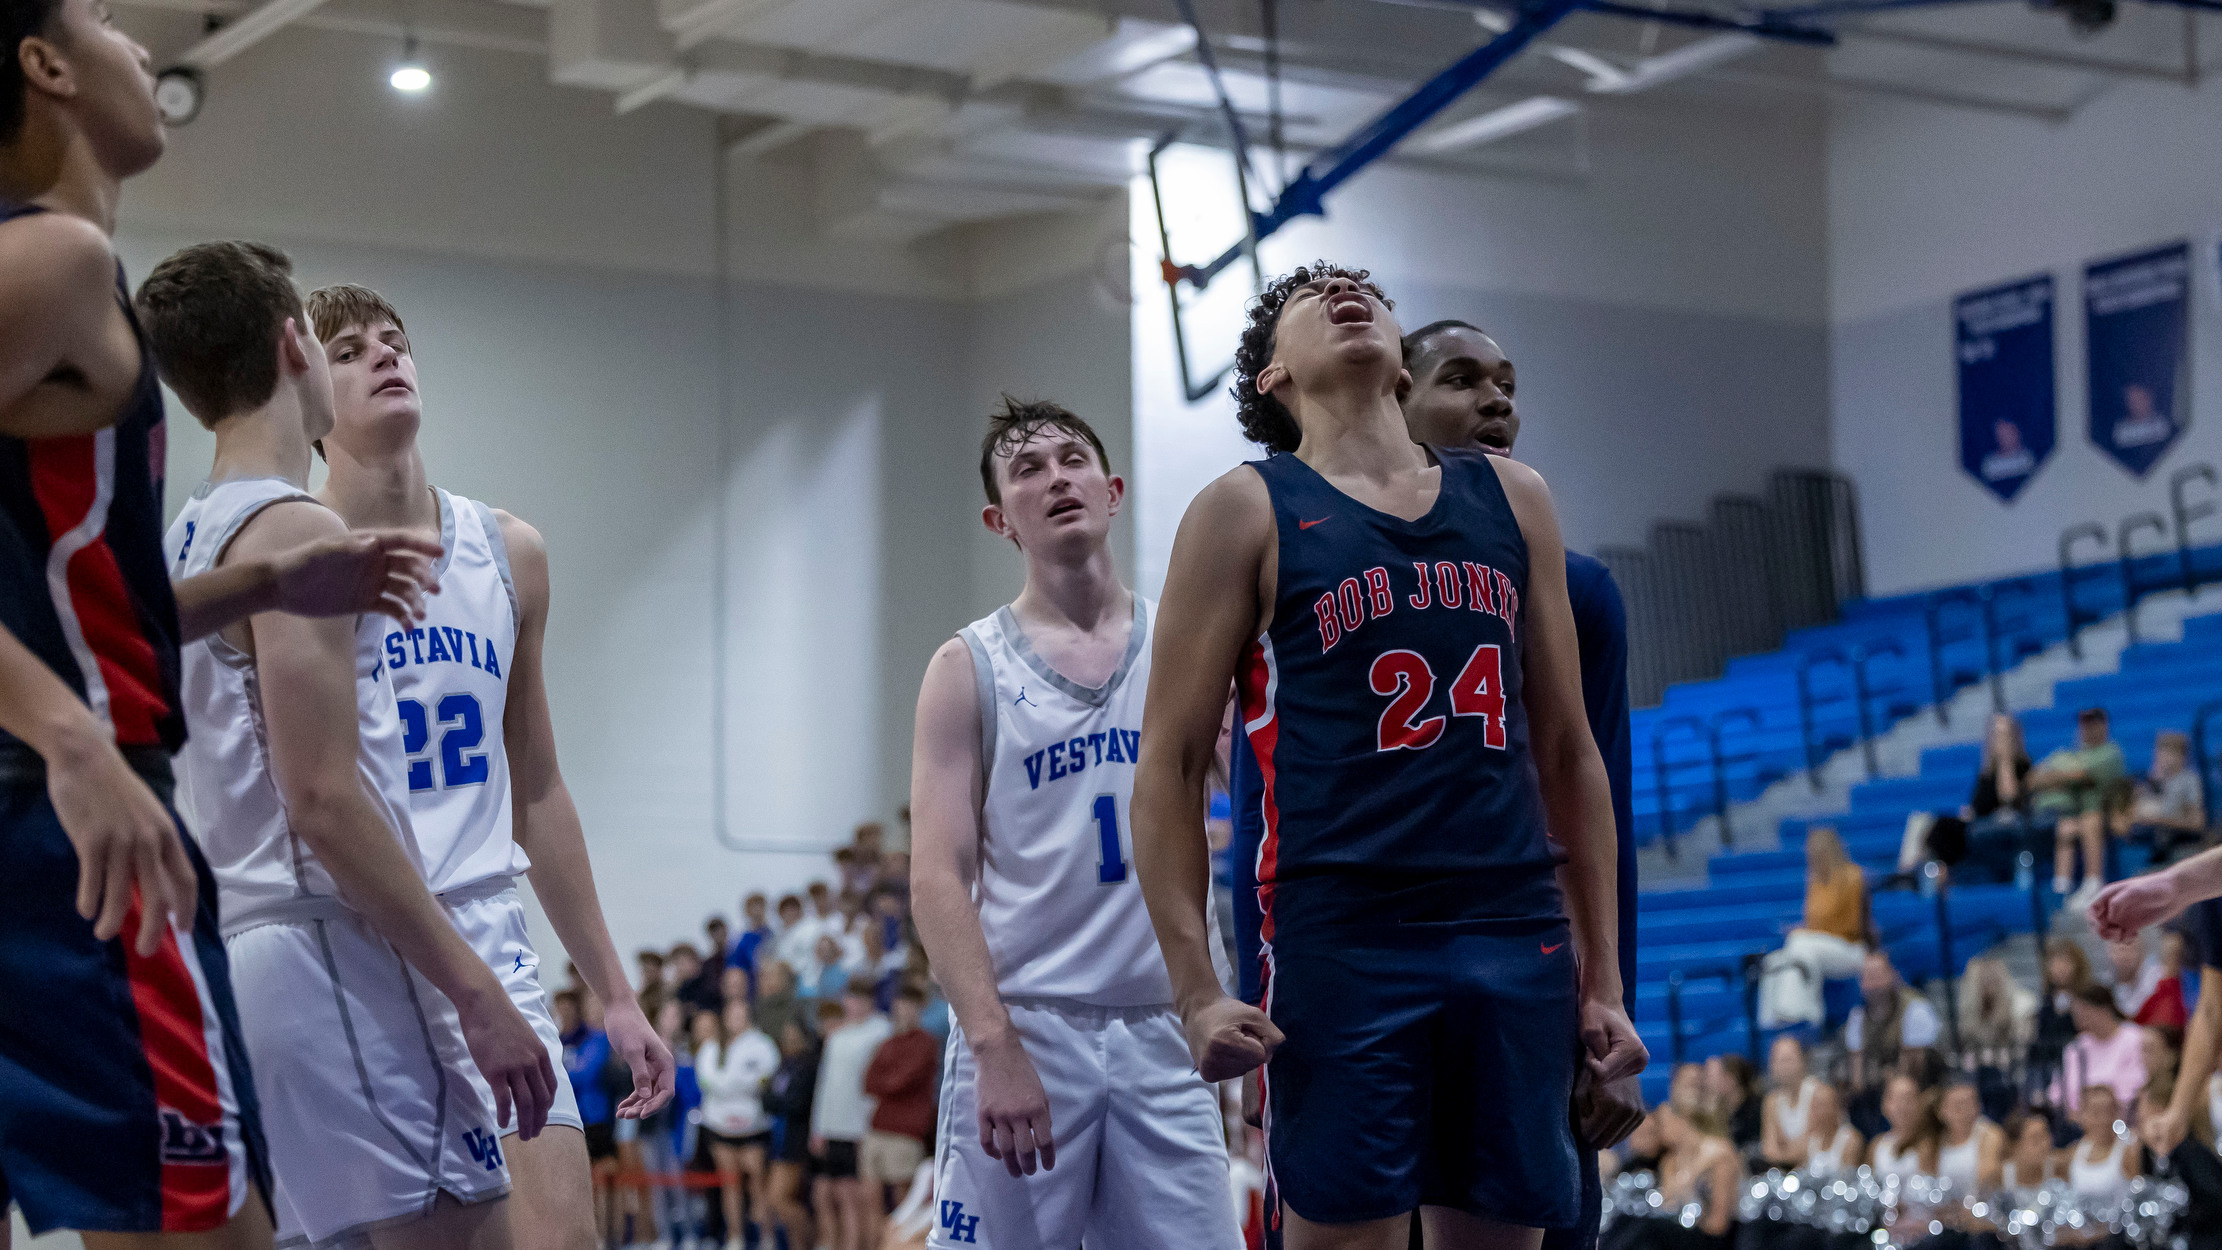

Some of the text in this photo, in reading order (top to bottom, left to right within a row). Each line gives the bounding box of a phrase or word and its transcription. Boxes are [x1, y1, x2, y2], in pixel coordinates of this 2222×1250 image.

[1314, 566, 1394, 655] BOB
[397, 691, 490, 794] 22
[1369, 644, 1506, 752] 24
[1090, 792, 1129, 886] 1
[462, 1126, 502, 1171] VH
[941, 1200, 980, 1244] VH
